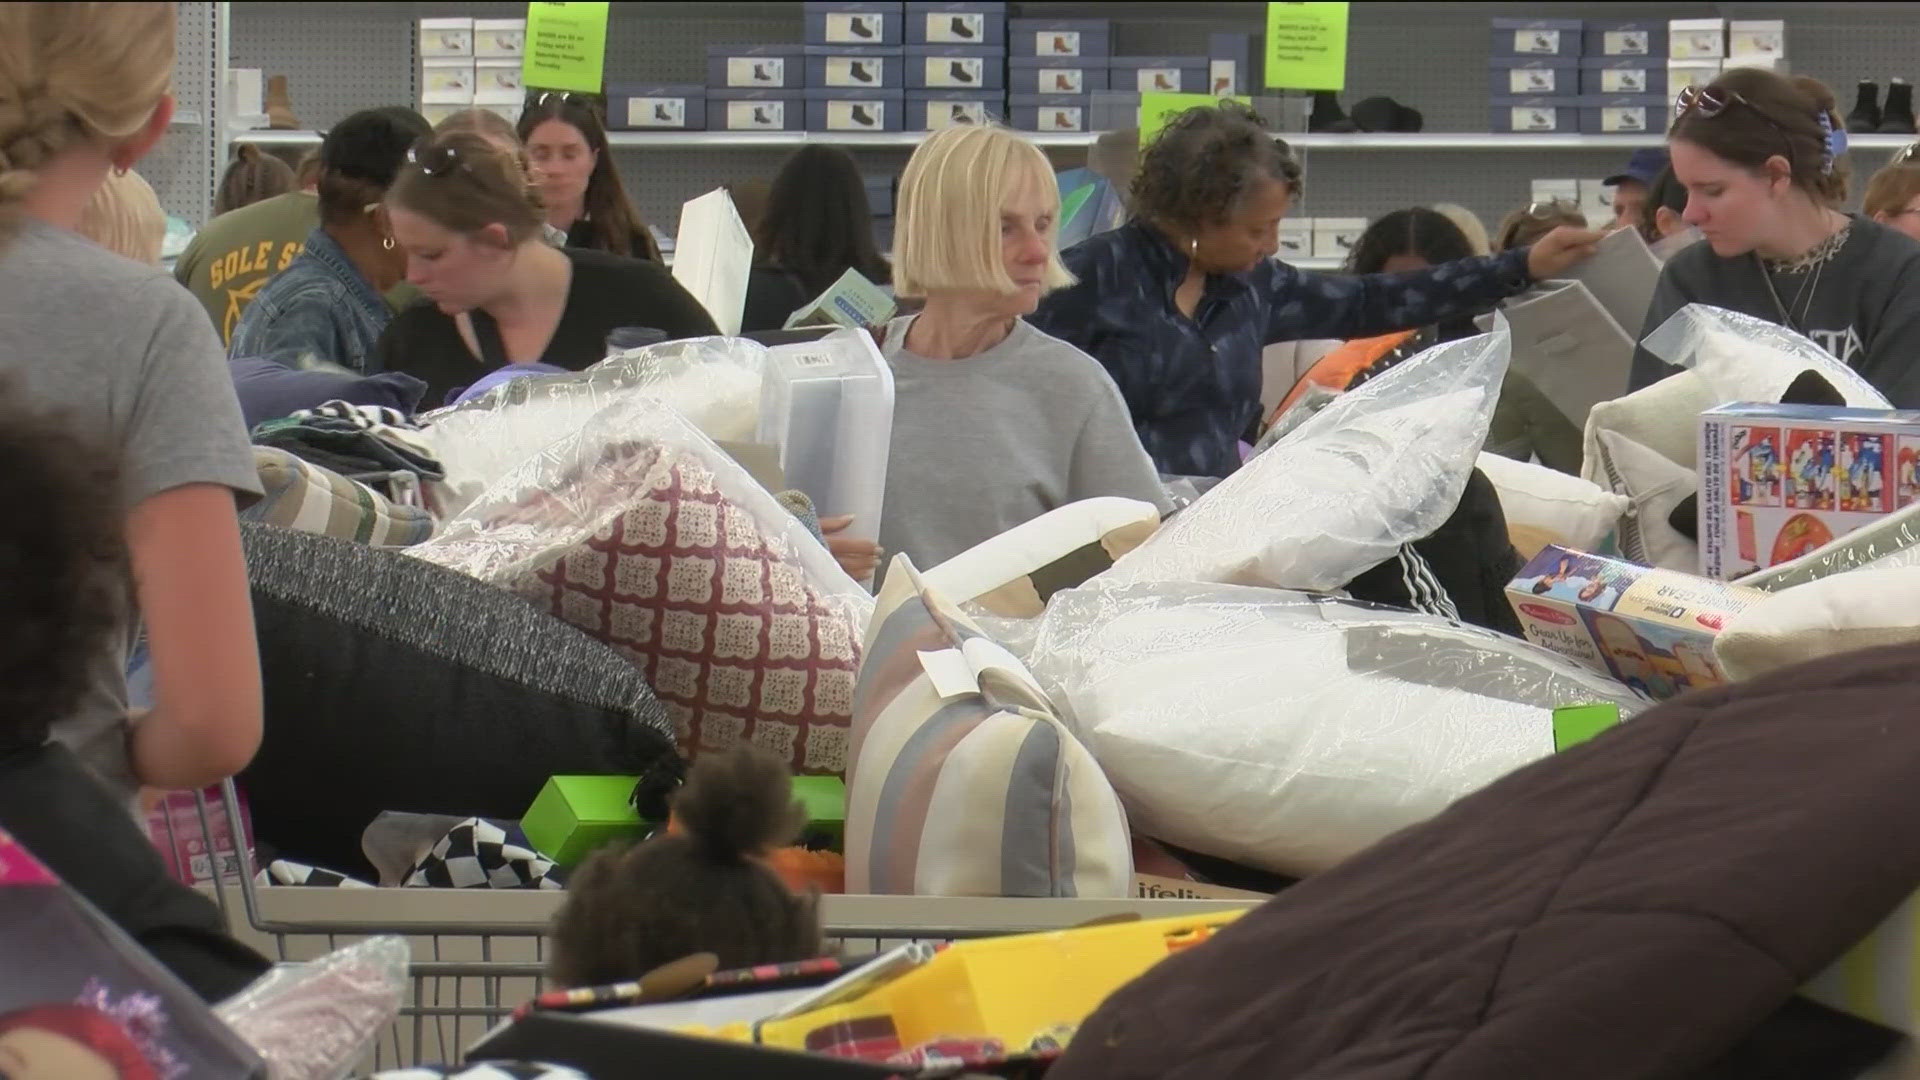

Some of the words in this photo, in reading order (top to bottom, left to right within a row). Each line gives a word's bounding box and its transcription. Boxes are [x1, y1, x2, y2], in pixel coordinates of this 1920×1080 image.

[210, 240, 273, 290] SOLE
[1529, 623, 1558, 640] Gear
[1557, 629, 1574, 645] Up
